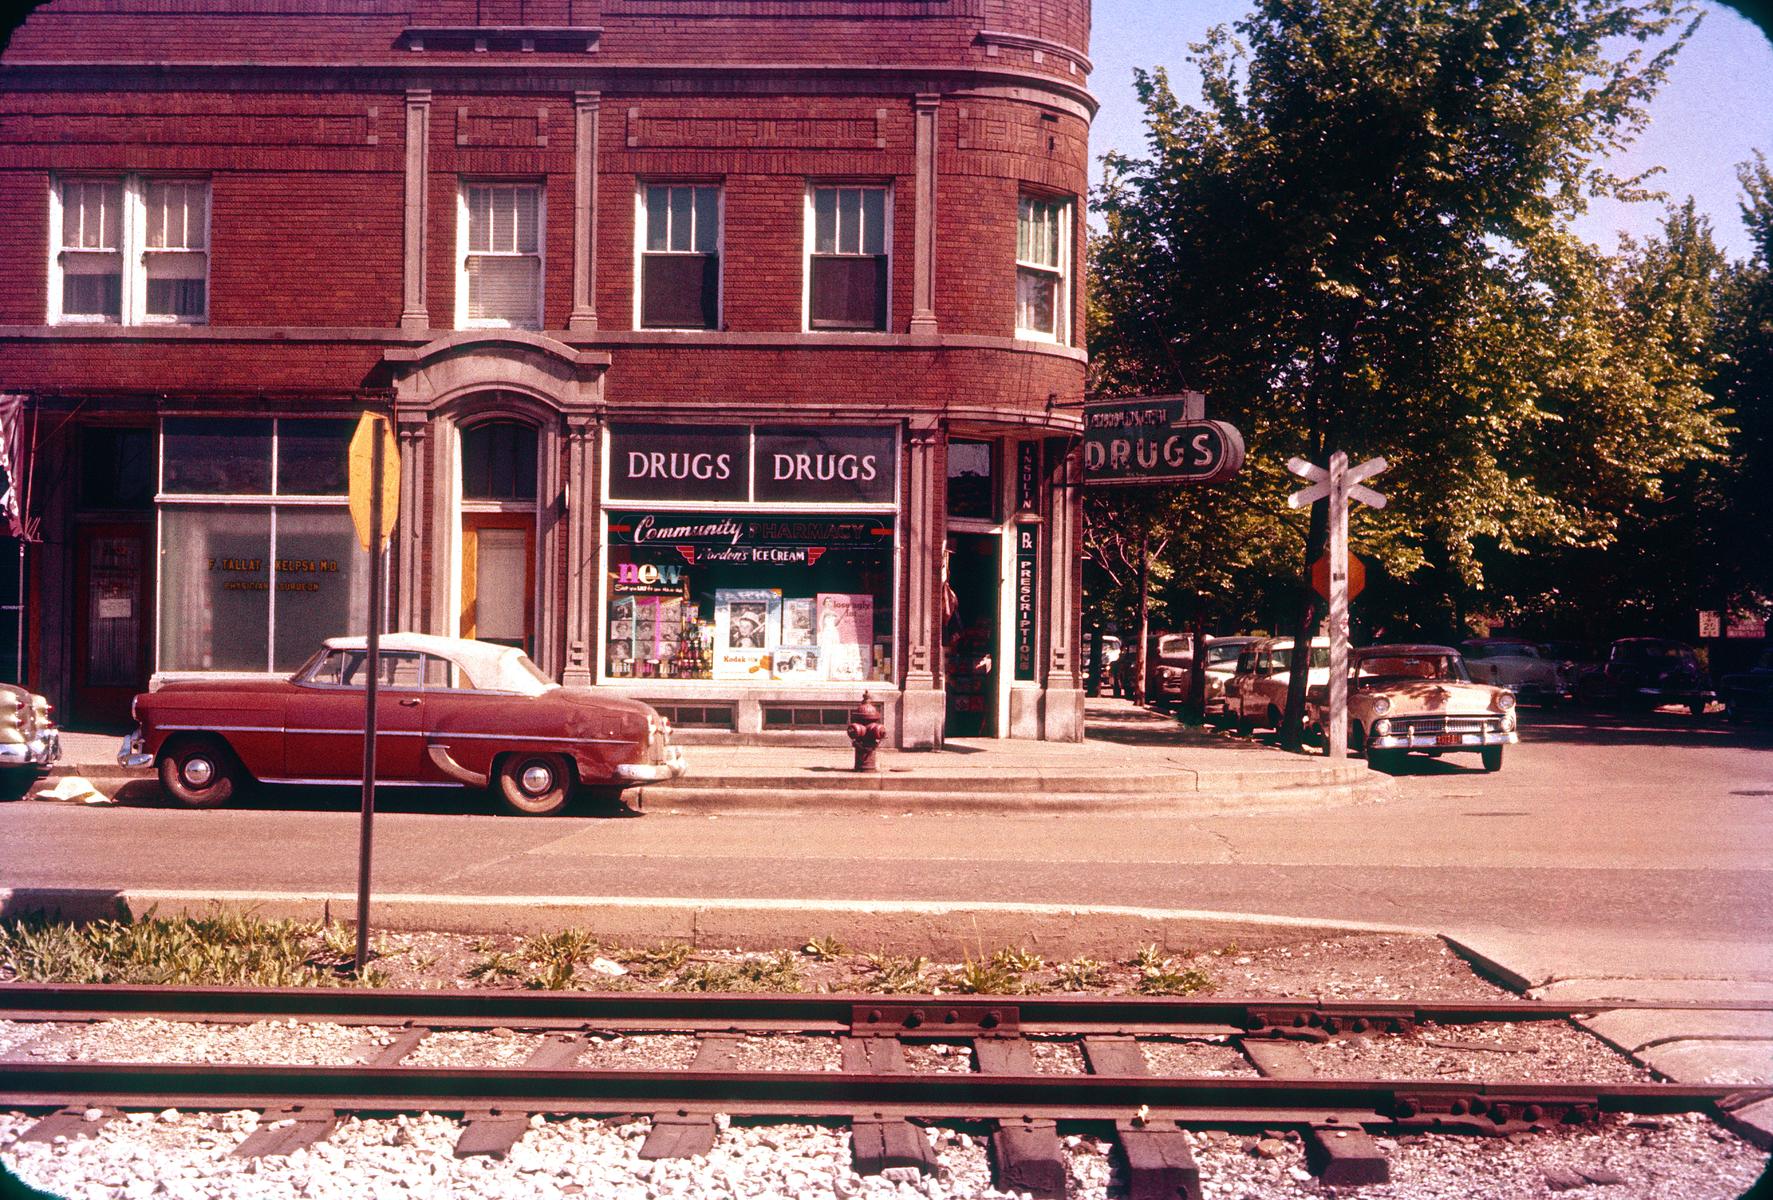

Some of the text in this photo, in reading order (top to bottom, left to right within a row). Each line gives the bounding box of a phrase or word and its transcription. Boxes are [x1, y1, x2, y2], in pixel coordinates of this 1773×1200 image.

[628, 452, 731, 479] DRUGS
[1085, 433, 1214, 471] DRUGS
[774, 454, 877, 481] DRUGS
[1021, 446, 1032, 509] INSULIN
[633, 514, 743, 544] Community
[222, 559, 261, 570] TALLAT
[275, 560, 316, 572] KELPSA
[752, 549, 769, 560] ICE
[770, 549, 805, 561] CREAM
[618, 563, 683, 584] new
[1020, 561, 1033, 671] PRESCRIPTIONS
[723, 655, 746, 663] Kodak
